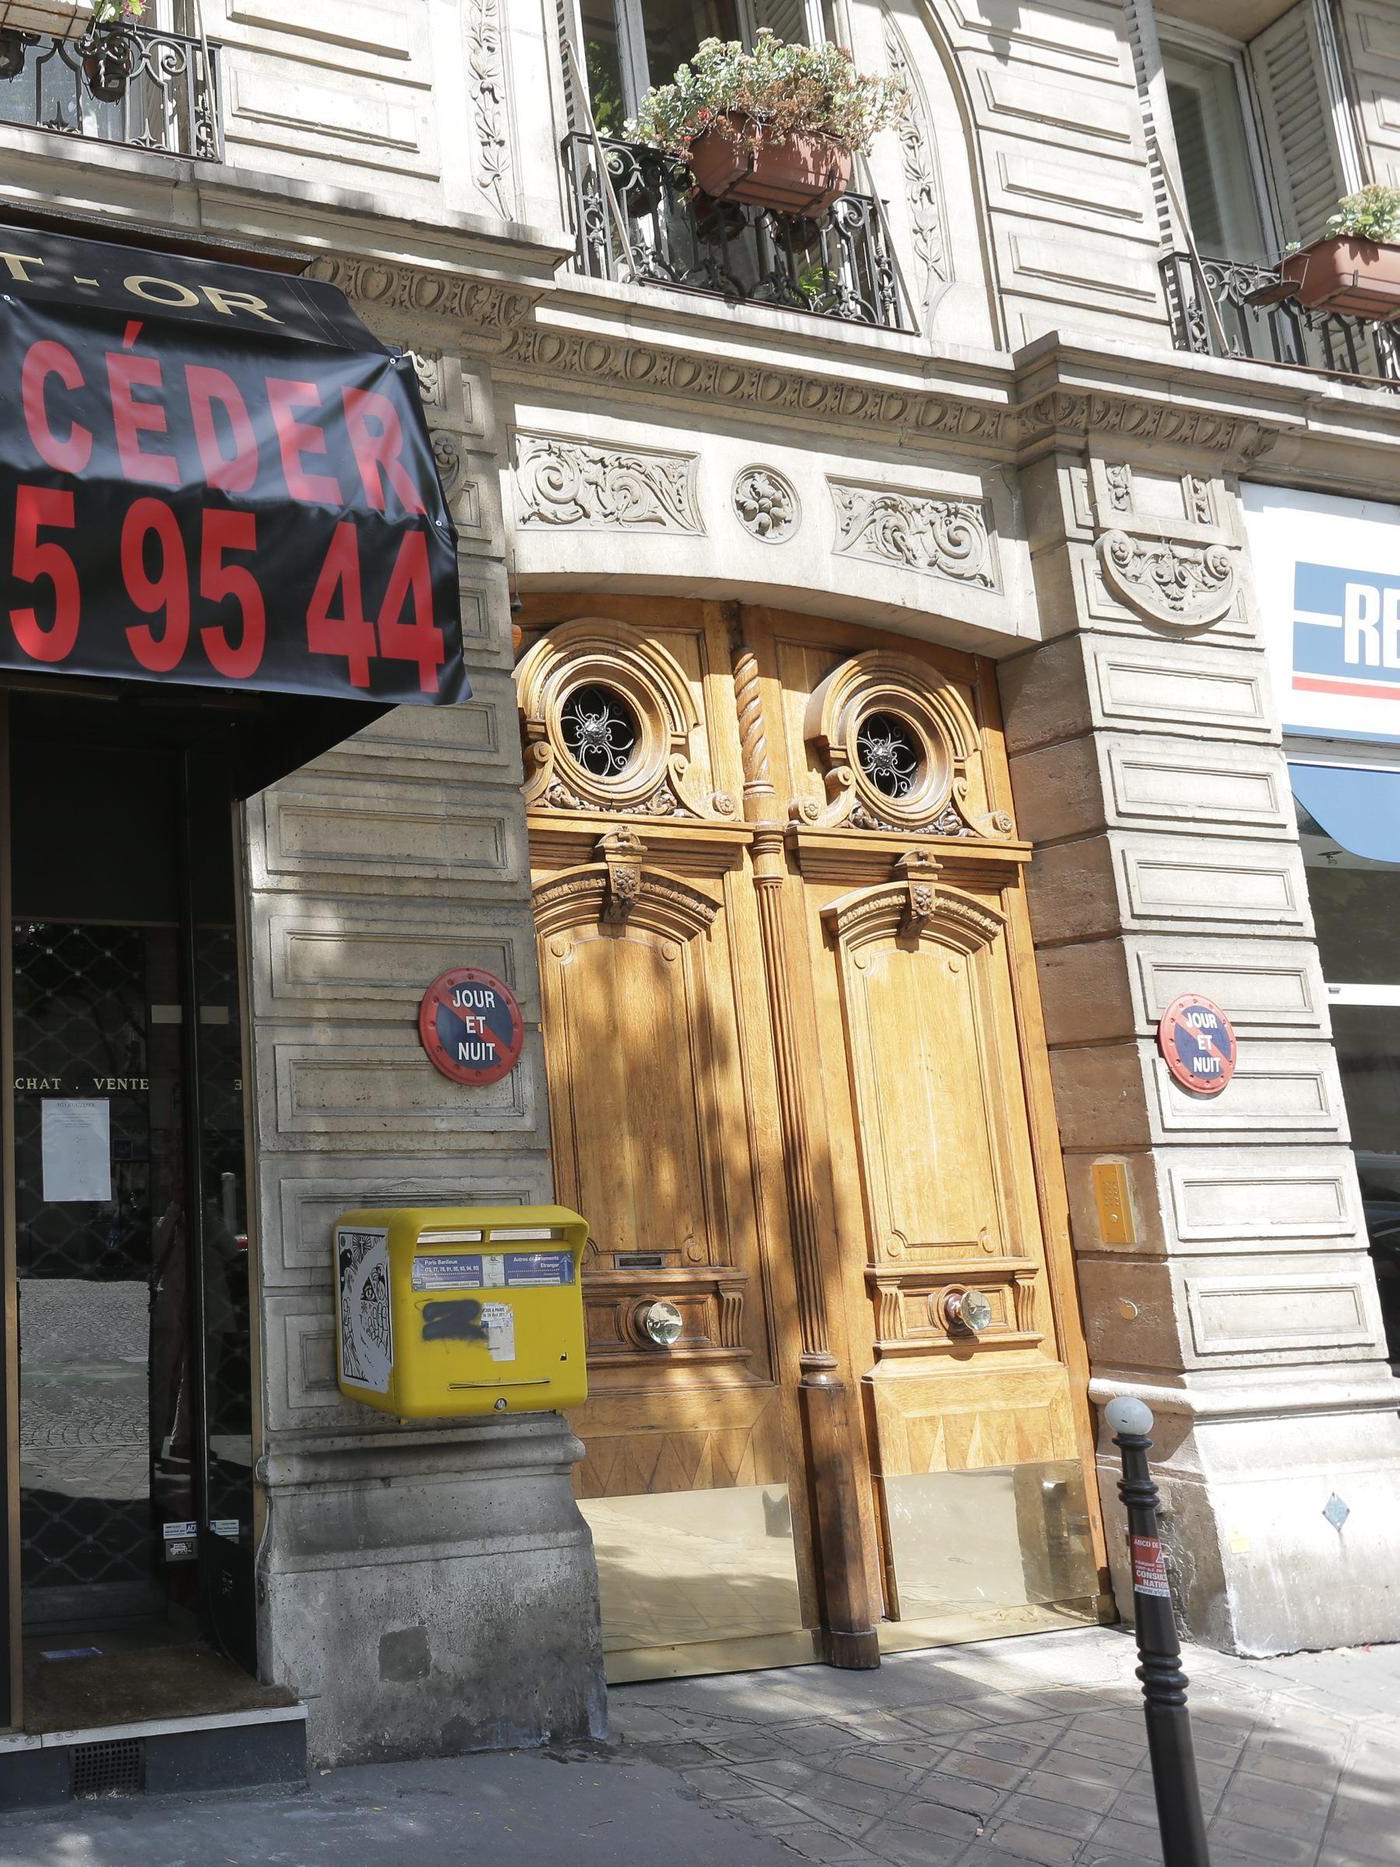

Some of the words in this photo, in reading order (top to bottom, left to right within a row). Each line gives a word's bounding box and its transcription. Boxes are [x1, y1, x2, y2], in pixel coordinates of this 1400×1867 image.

[122, 274, 286, 325] OR
[21, 319, 428, 514] CÉDER
[119, 496, 267, 680] 95
[305, 521, 447, 693] 44
[452, 989, 496, 1009] JOUR
[465, 1015, 486, 1034] ET
[1186, 1012, 1218, 1029] JOUR
[458, 1042, 496, 1061] NUIT
[1197, 1034, 1213, 1050] ET
[1193, 1056, 1221, 1073] NUIT
[13, 1077, 62, 1090] CHAT
[93, 1078, 150, 1090] VENTE
